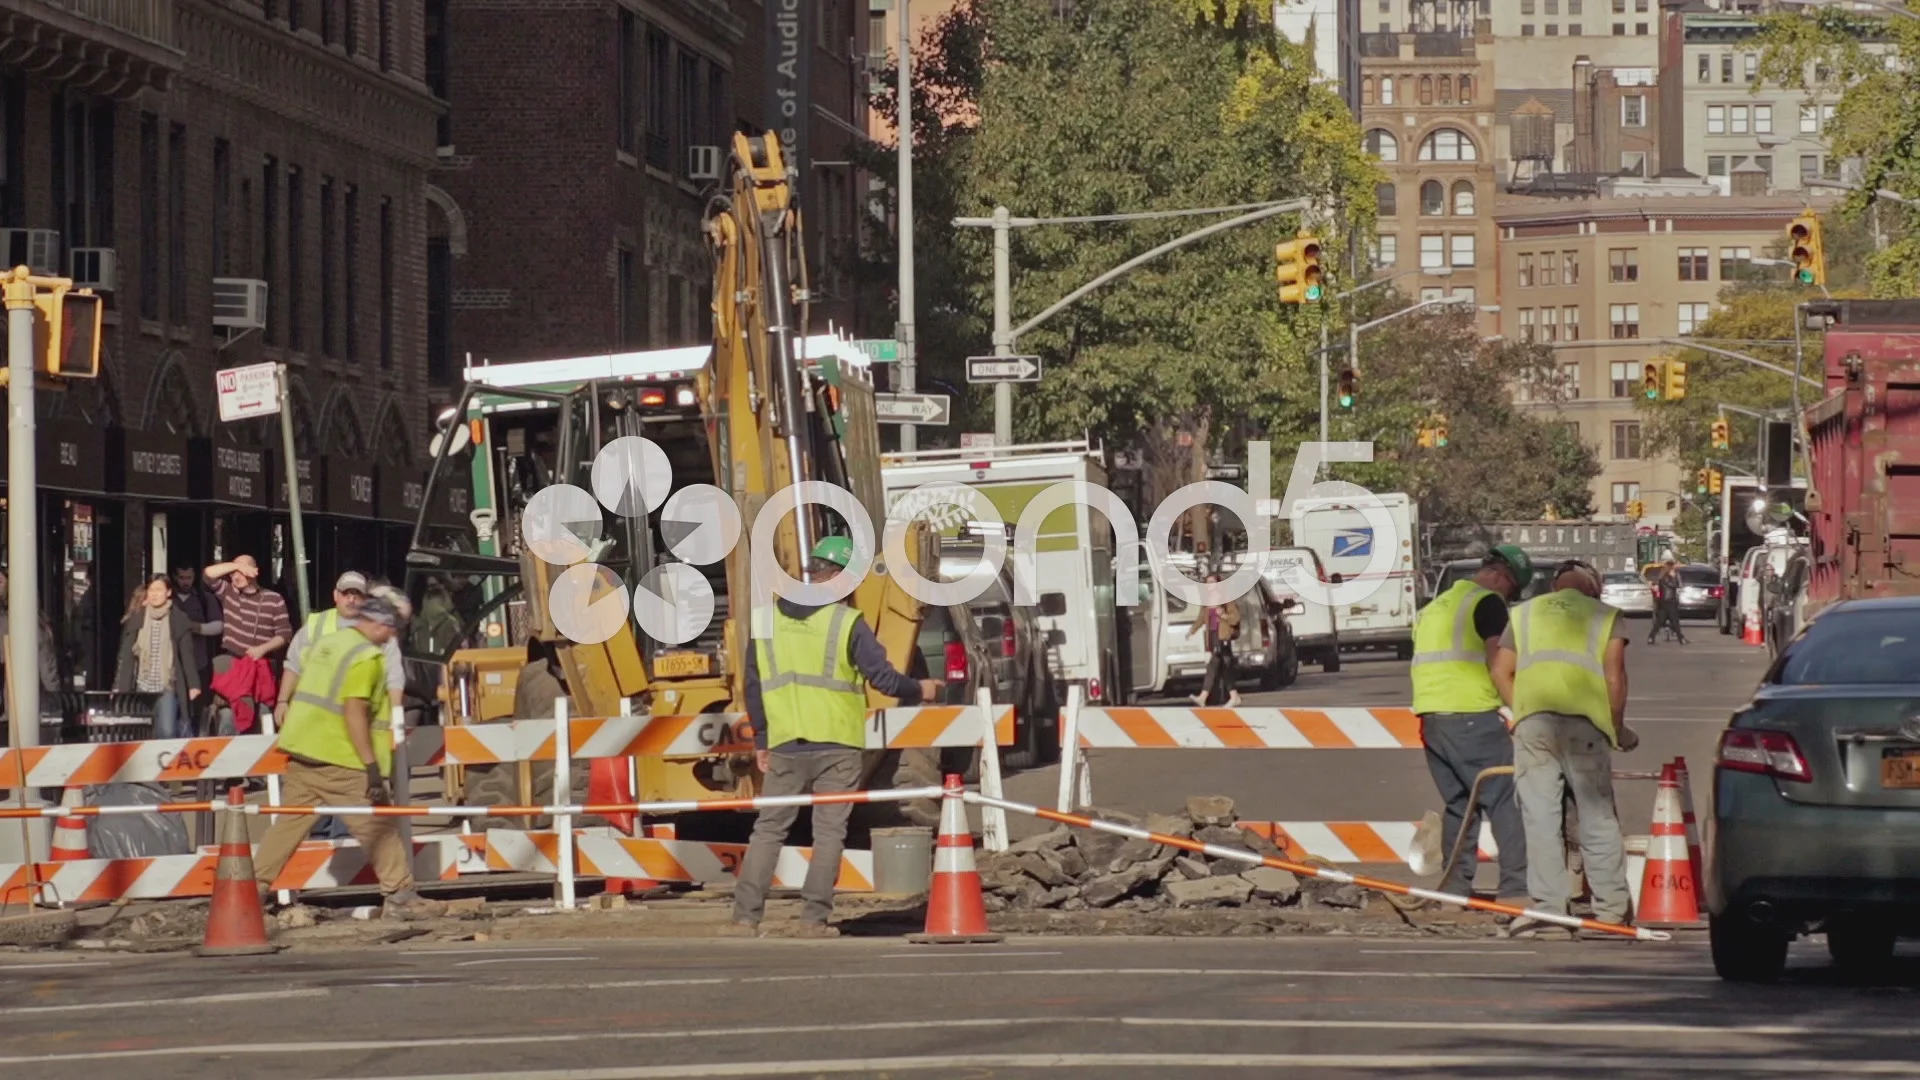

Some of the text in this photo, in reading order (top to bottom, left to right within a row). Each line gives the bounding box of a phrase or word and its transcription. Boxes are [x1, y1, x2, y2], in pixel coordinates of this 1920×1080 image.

[776, 88, 797, 117] of
[978, 365, 1028, 374] ONE WAY
[221, 373, 235, 391] NO
[911, 404, 934, 414] WAY
[1502, 528, 1598, 543] CASTLE
[697, 721, 754, 747] CAC
[157, 748, 210, 771] CAC
[1650, 873, 1691, 891] CAC
